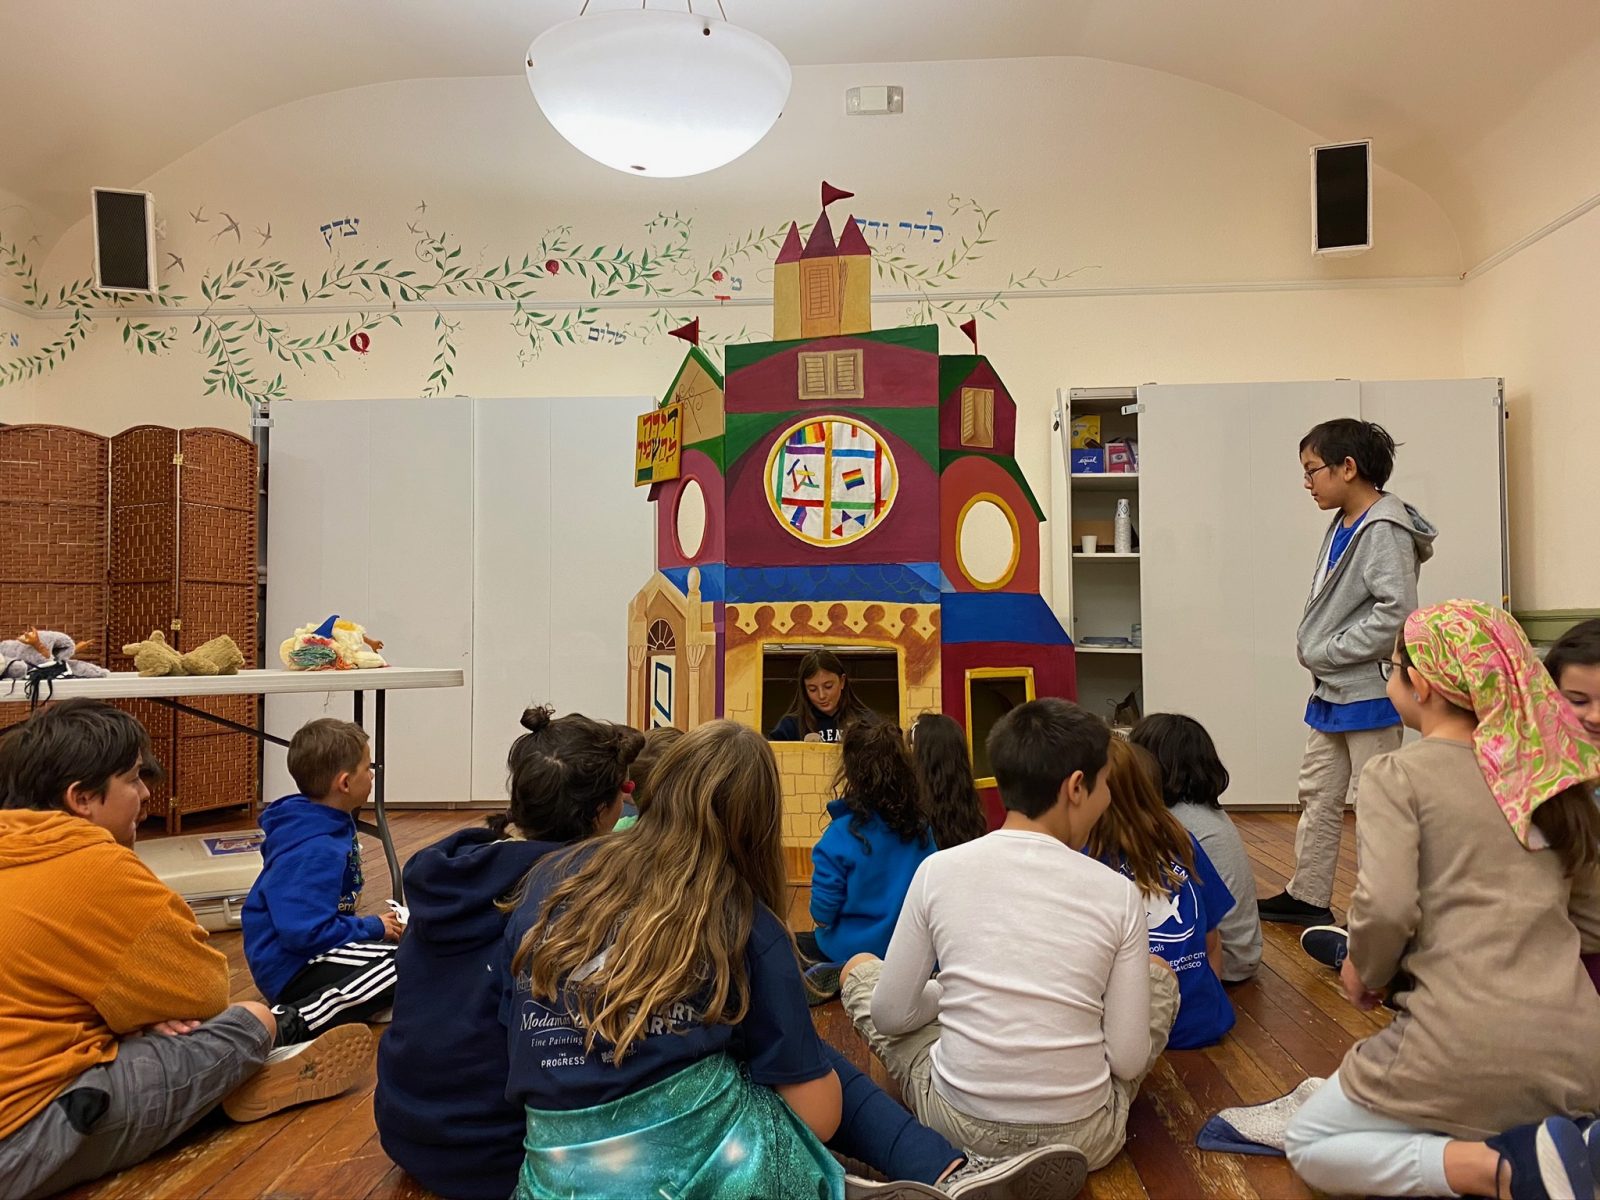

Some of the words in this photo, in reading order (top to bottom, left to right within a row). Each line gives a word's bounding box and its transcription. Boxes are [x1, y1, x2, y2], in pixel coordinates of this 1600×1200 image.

[320, 217, 360, 253] צדק
[588, 322, 627, 345] שלום
[1077, 456, 1097, 466] equal
[1193, 951, 1206, 959] CITY
[531, 1038, 546, 1047] Fine
[548, 1035, 584, 1047] Painting
[541, 1056, 585, 1069] PROGRESS
